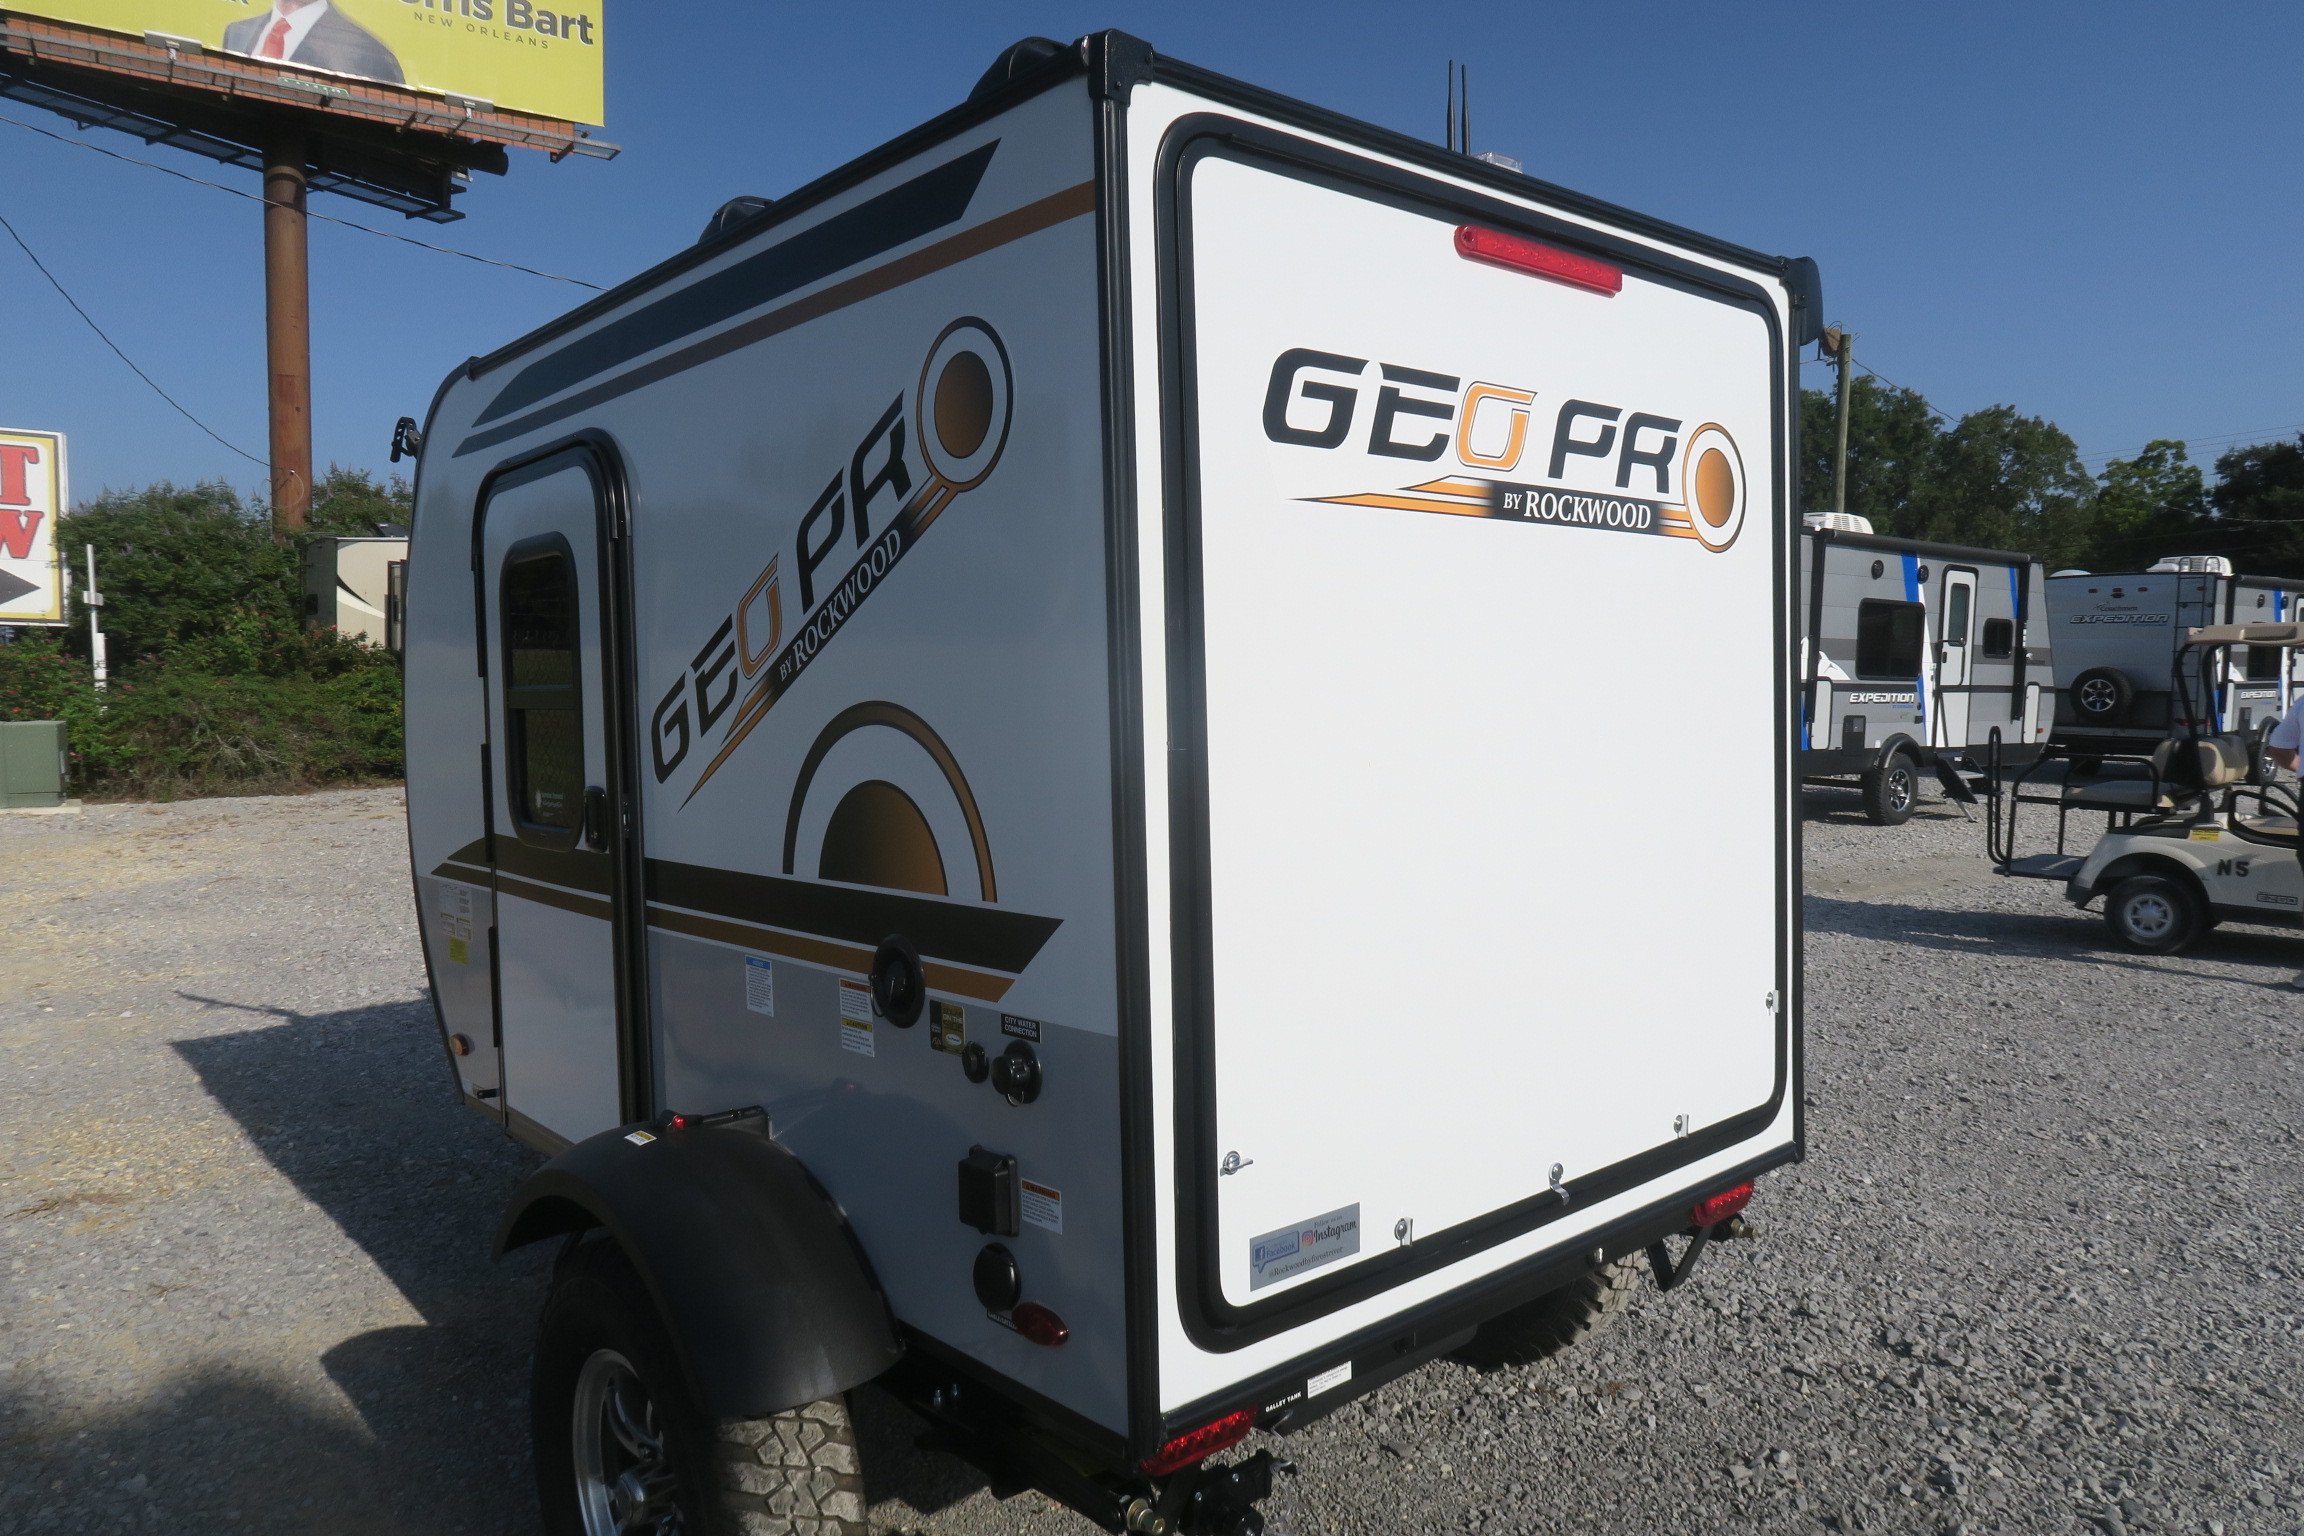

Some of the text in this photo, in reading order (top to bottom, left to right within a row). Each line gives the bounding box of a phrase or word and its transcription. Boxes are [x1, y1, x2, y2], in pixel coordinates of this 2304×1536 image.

[414, 12, 549, 49] NEW ORLEANS
[506, 0, 593, 45] Bart
[1262, 347, 1538, 472] GEO
[1503, 490, 1652, 530] BY ROCKWOOD
[779, 528, 902, 682] BY ROCKWOOD
[2069, 613, 2169, 624] EXPEDITION
[651, 552, 783, 785] GEO
[1849, 692, 1915, 704] EXPEDITION
[1004, 1016, 1037, 1030] CITY WATER
[1004, 1023, 1038, 1038] CONNECTION
[1313, 1219, 1357, 1244] Instagram
[1266, 1242, 1297, 1258] Facebook
[1285, 1391, 1302, 1405] TANK
